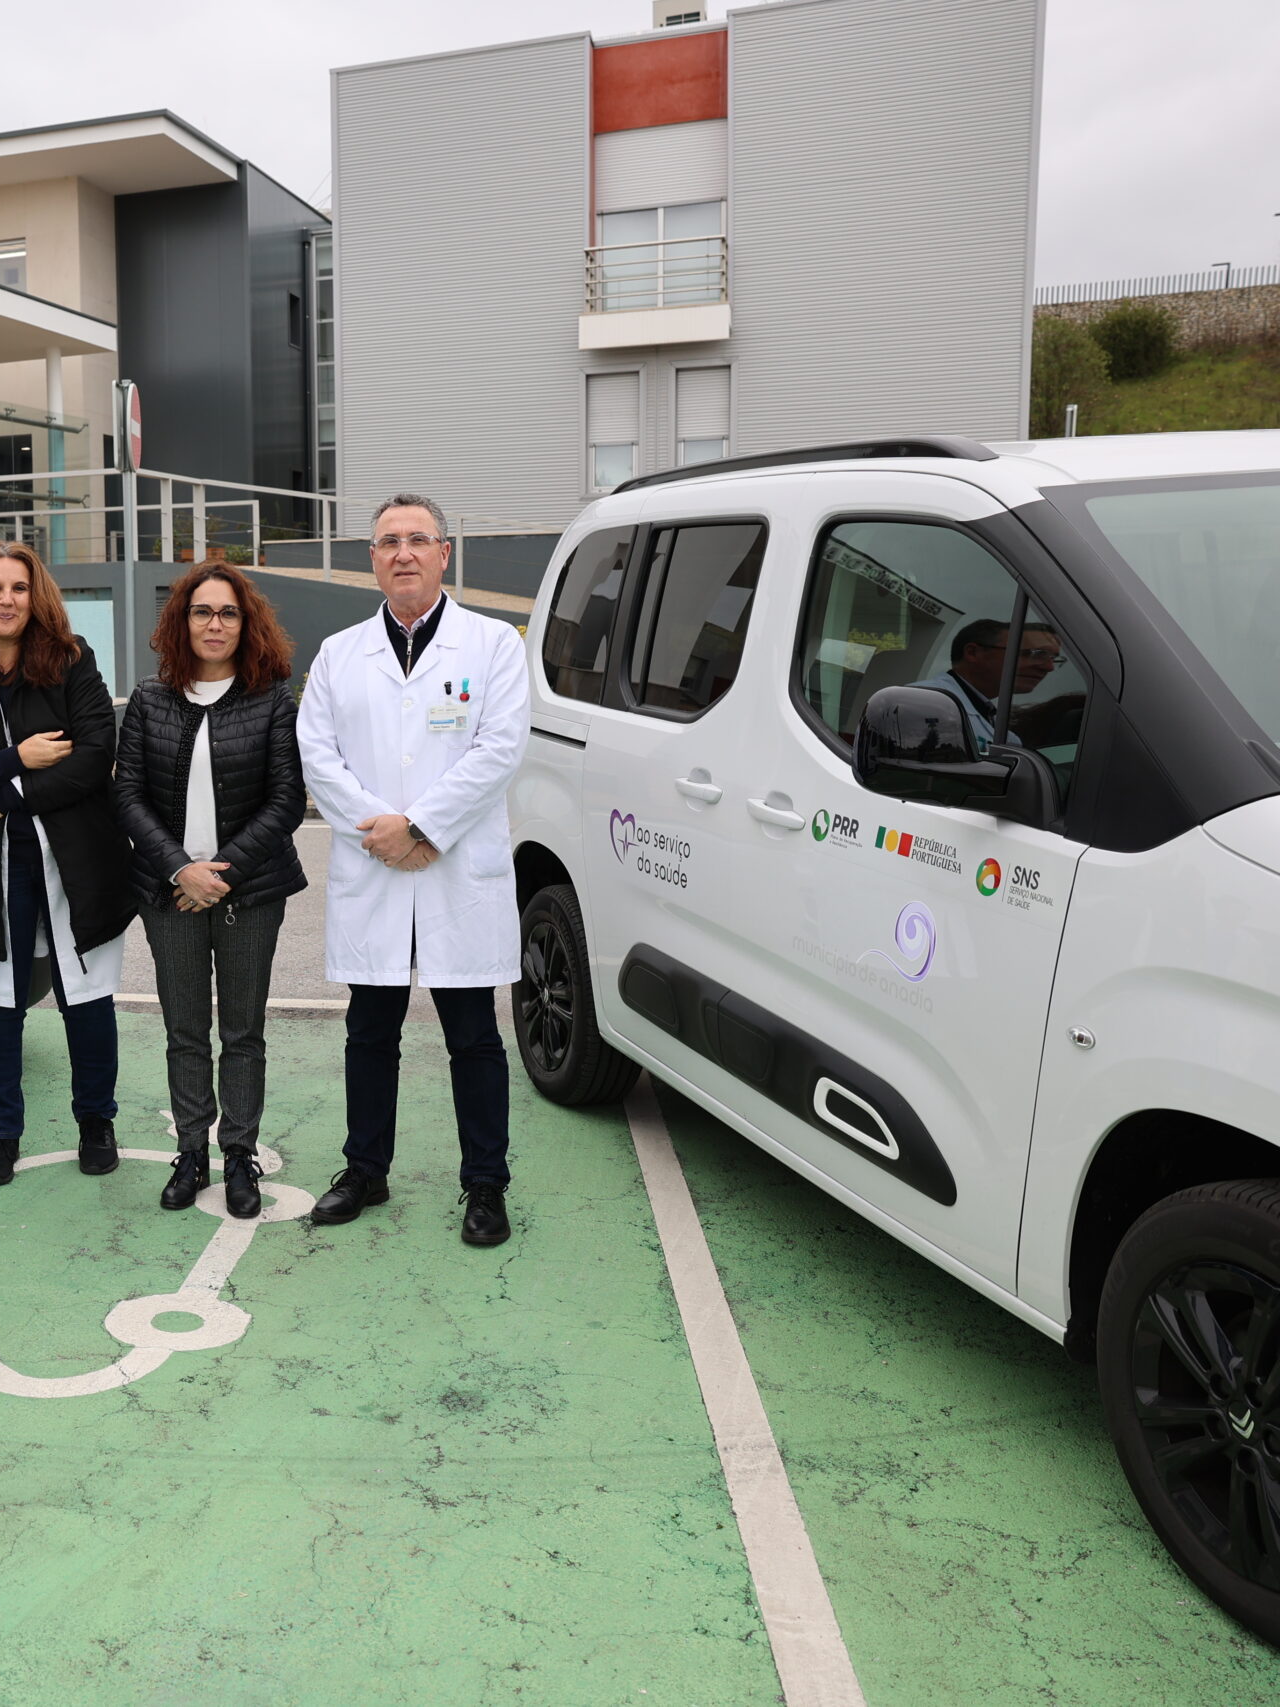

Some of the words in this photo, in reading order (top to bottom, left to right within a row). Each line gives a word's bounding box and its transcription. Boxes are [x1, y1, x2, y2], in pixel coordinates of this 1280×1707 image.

[831, 813, 860, 839] PRR
[637, 827, 651, 845] ao
[654, 834, 691, 862] serviço
[913, 836, 957, 858] REPÚBLICA
[637, 850, 651, 874] da
[654, 862, 688, 888] saúde
[911, 848, 962, 874] PORTUGUESA
[1012, 865, 1041, 890] SNS
[1030, 891, 1054, 906] NACIONAL
[858, 965, 877, 986] de
[879, 977, 934, 1014] anadia
